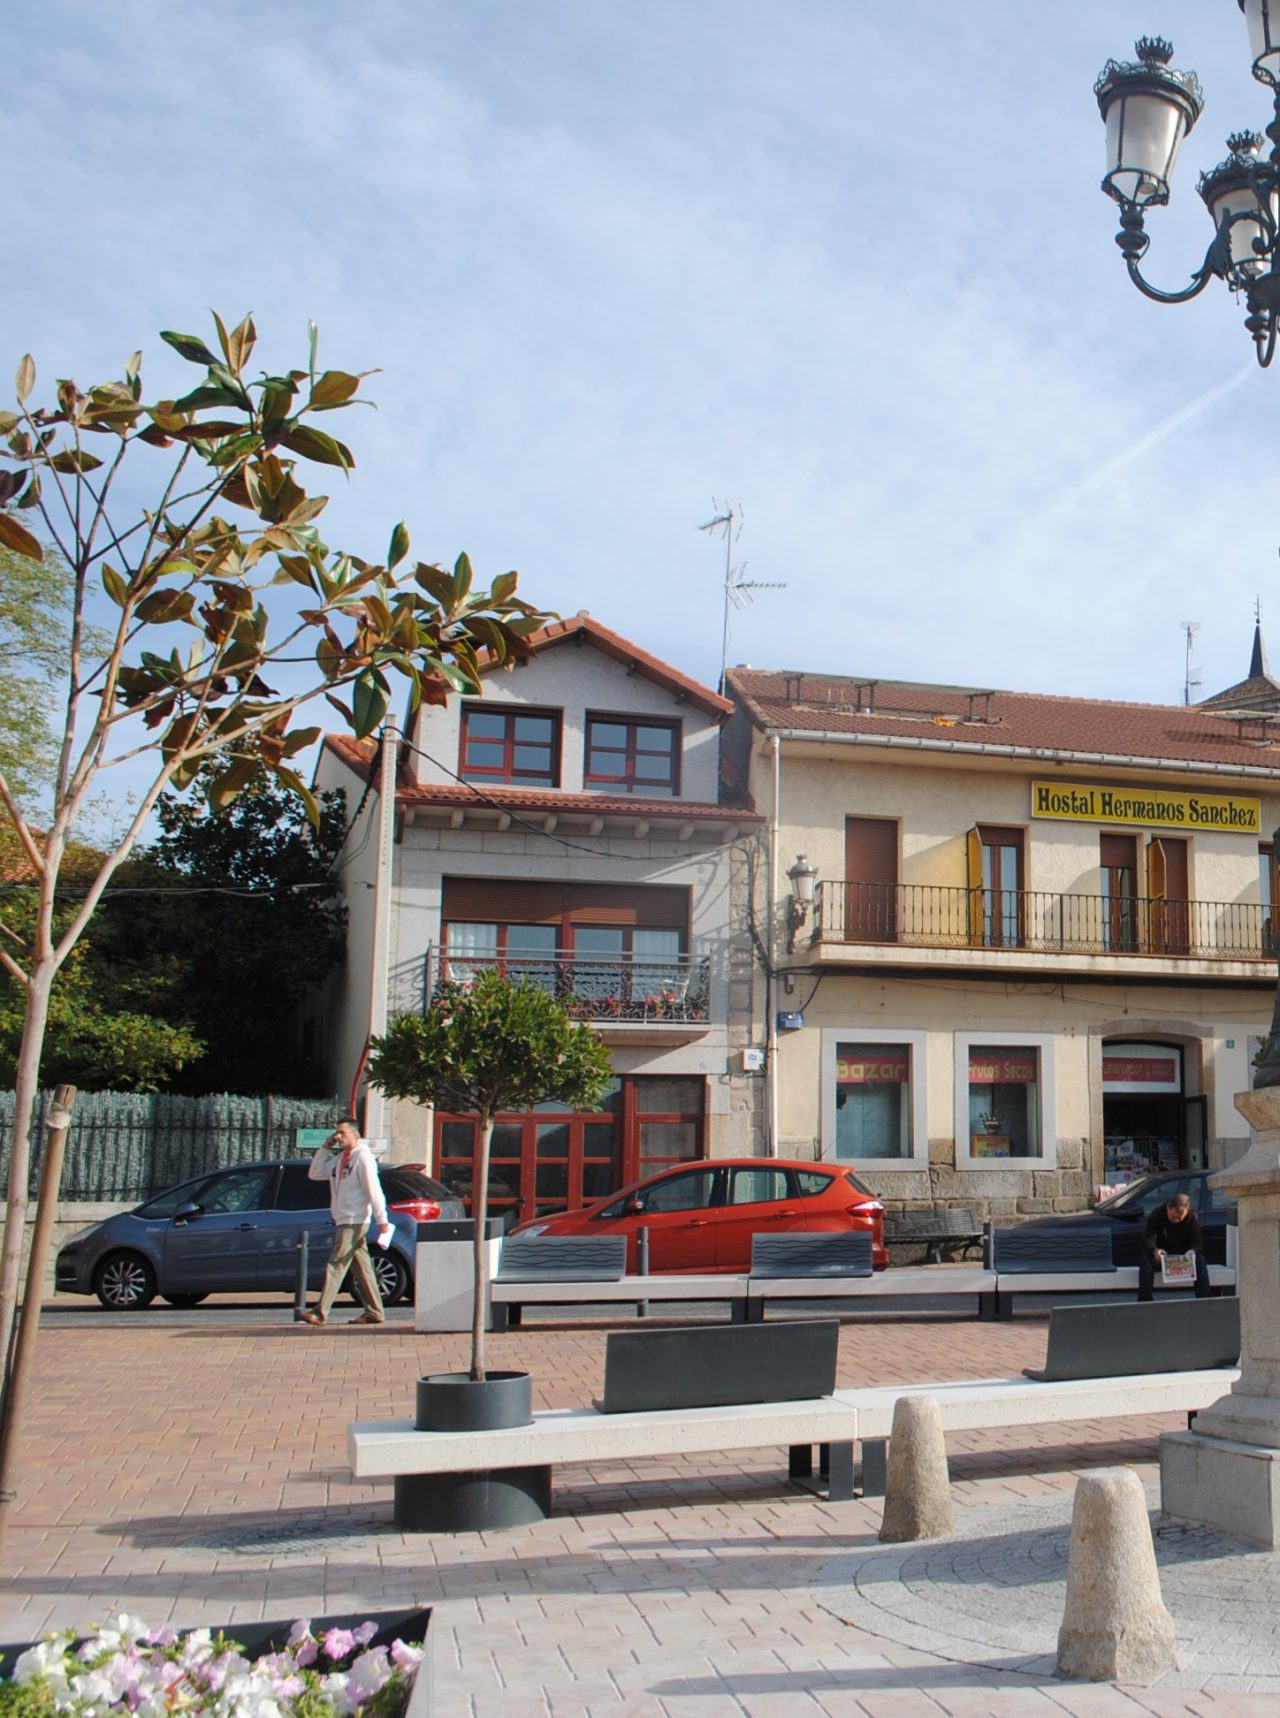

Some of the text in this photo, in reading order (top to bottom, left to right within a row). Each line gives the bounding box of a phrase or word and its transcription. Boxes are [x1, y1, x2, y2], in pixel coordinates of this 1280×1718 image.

[1037, 786, 1256, 827] Hostal Hermanos Sanchez
[836, 1059, 907, 1079] Bazar
